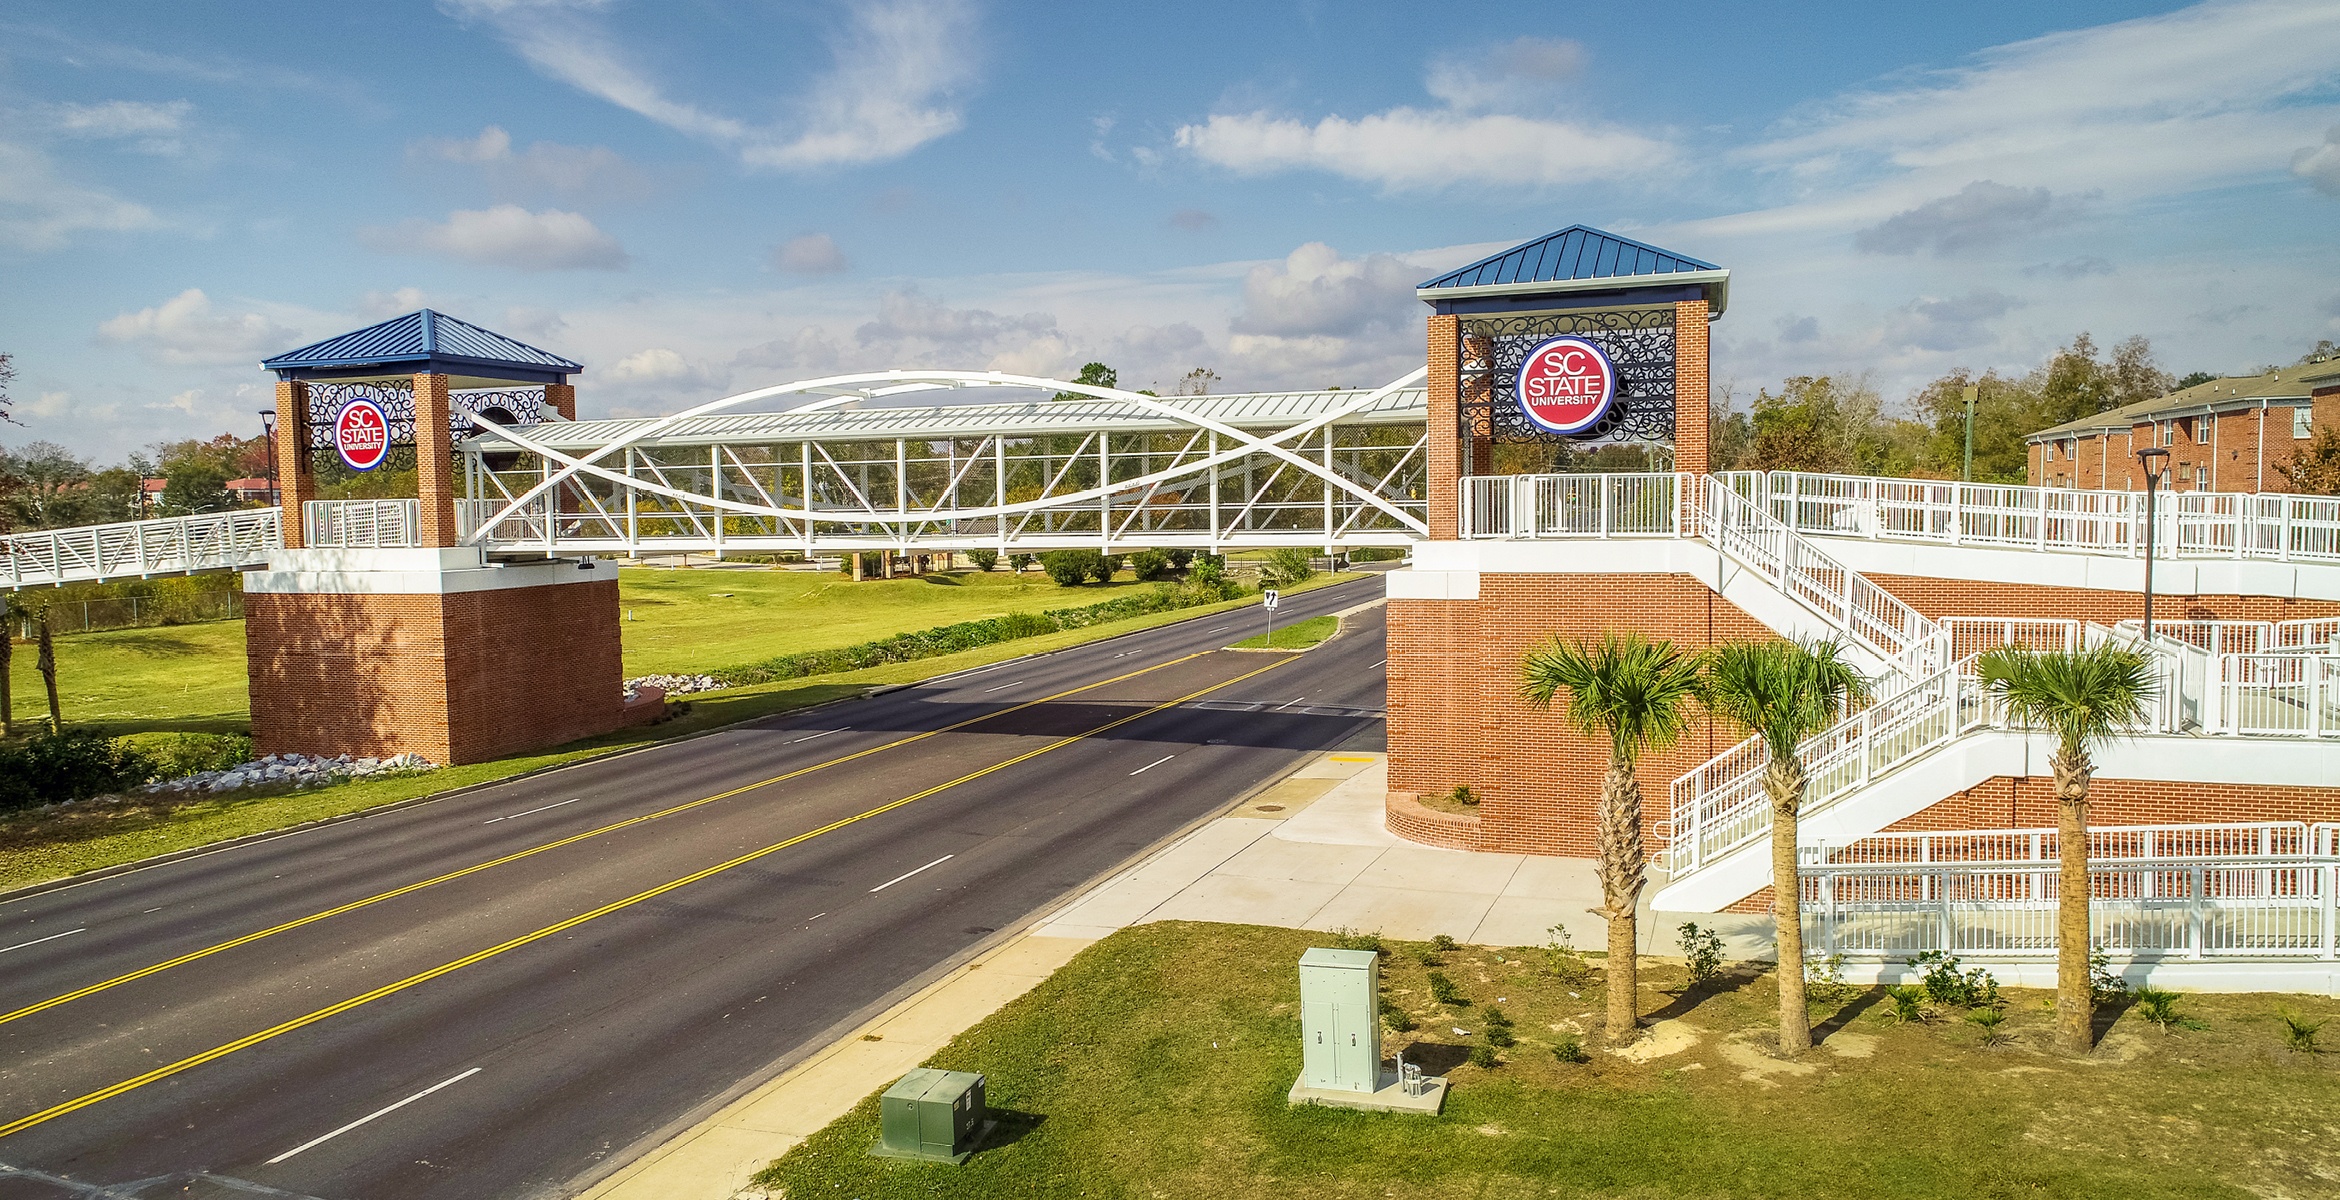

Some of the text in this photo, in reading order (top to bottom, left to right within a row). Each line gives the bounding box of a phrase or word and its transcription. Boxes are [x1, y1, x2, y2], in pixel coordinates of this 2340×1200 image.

[1543, 351, 1586, 376] SC
[1528, 375, 1601, 396] STATE
[1531, 395, 1598, 406] UNIVERSITY
[348, 409, 373, 428] SC
[341, 427, 383, 443] STATE
[344, 441, 381, 450] UNIVERSITY
